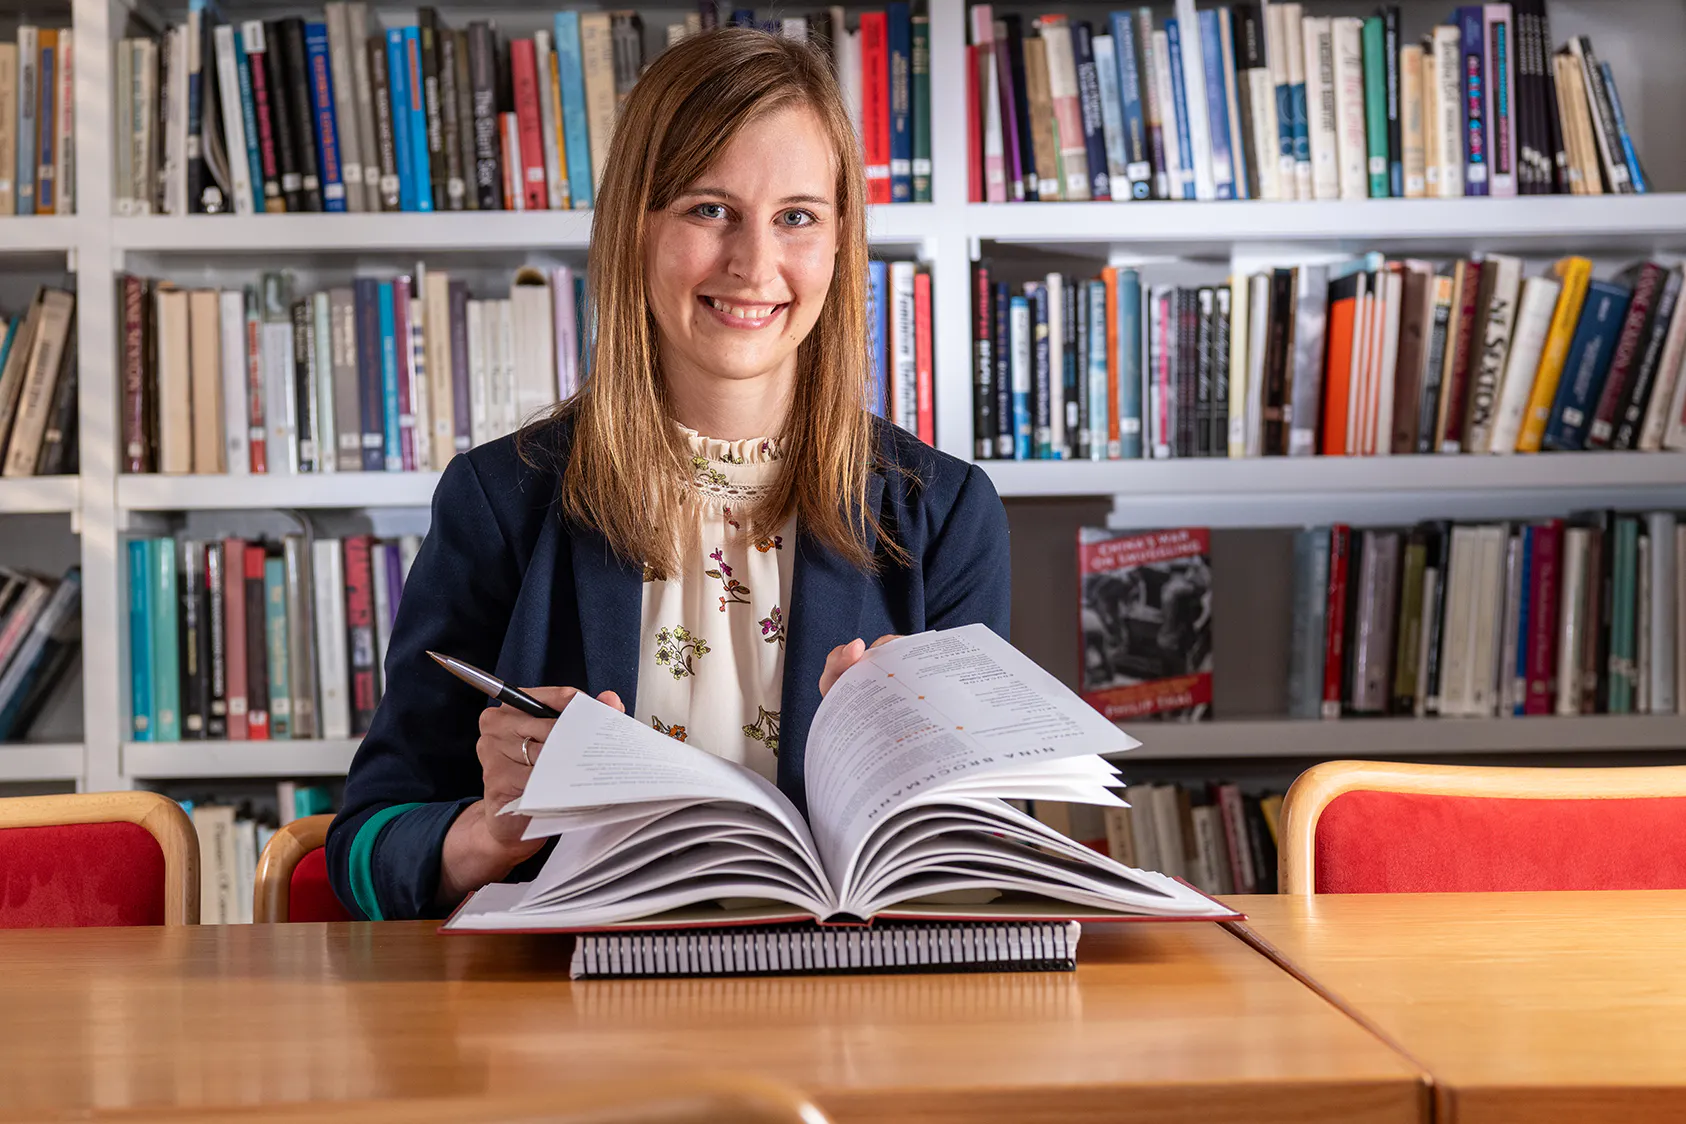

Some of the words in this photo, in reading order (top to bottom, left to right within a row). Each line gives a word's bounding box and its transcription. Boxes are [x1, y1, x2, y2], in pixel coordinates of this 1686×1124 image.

[475, 90, 493, 117] The
[475, 118, 495, 158] Silent
[477, 159, 497, 186] Sex
[126, 281, 141, 323] ANNE
[126, 328, 141, 392] SEXTON
[1158, 529, 1189, 546] WAR
[1090, 555, 1115, 571] ON
[1003, 746, 1055, 760] NINA
[867, 756, 994, 820] BROCKMANN
